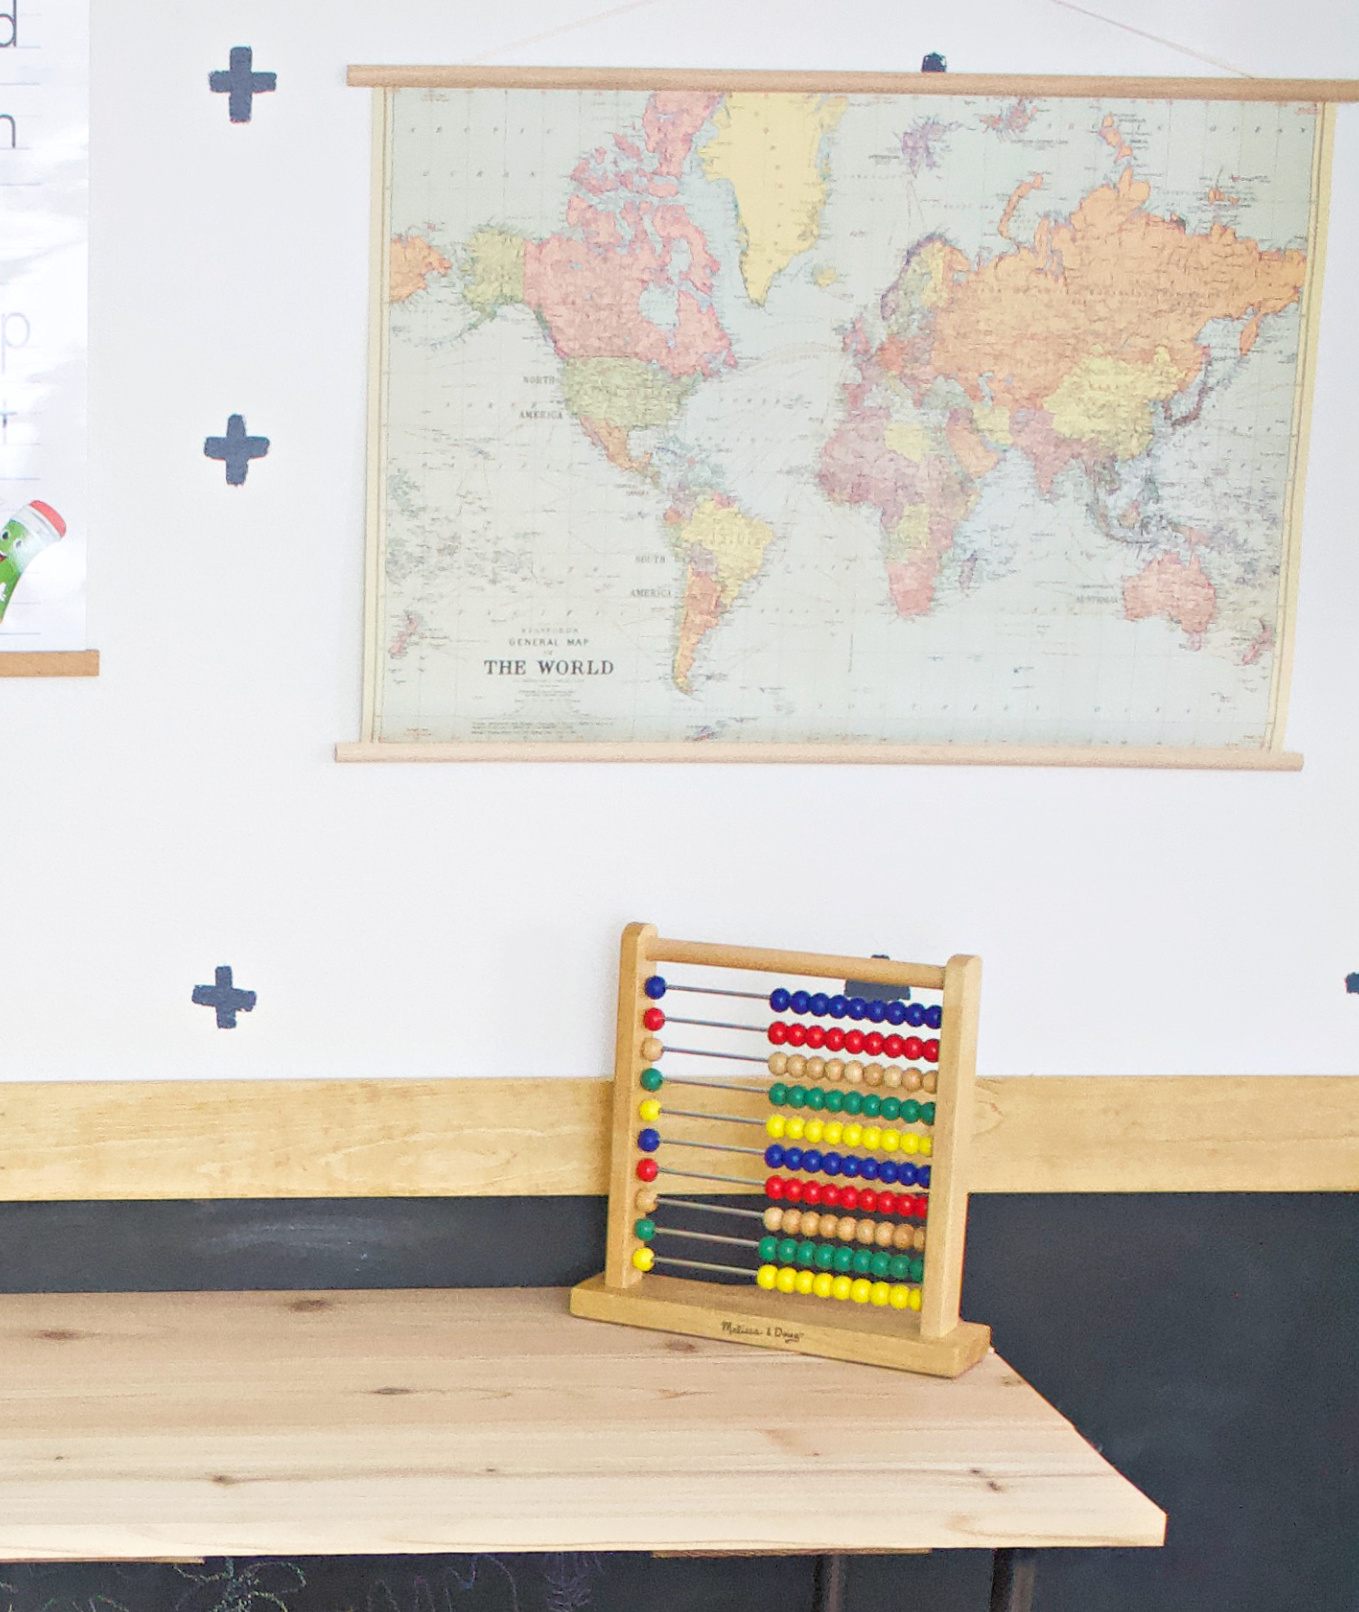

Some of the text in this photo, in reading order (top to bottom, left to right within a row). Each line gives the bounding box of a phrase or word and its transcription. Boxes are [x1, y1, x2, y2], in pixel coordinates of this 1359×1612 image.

[508, 637, 590, 648] GENERAL MAP
[483, 659, 615, 676] THE WORLD
